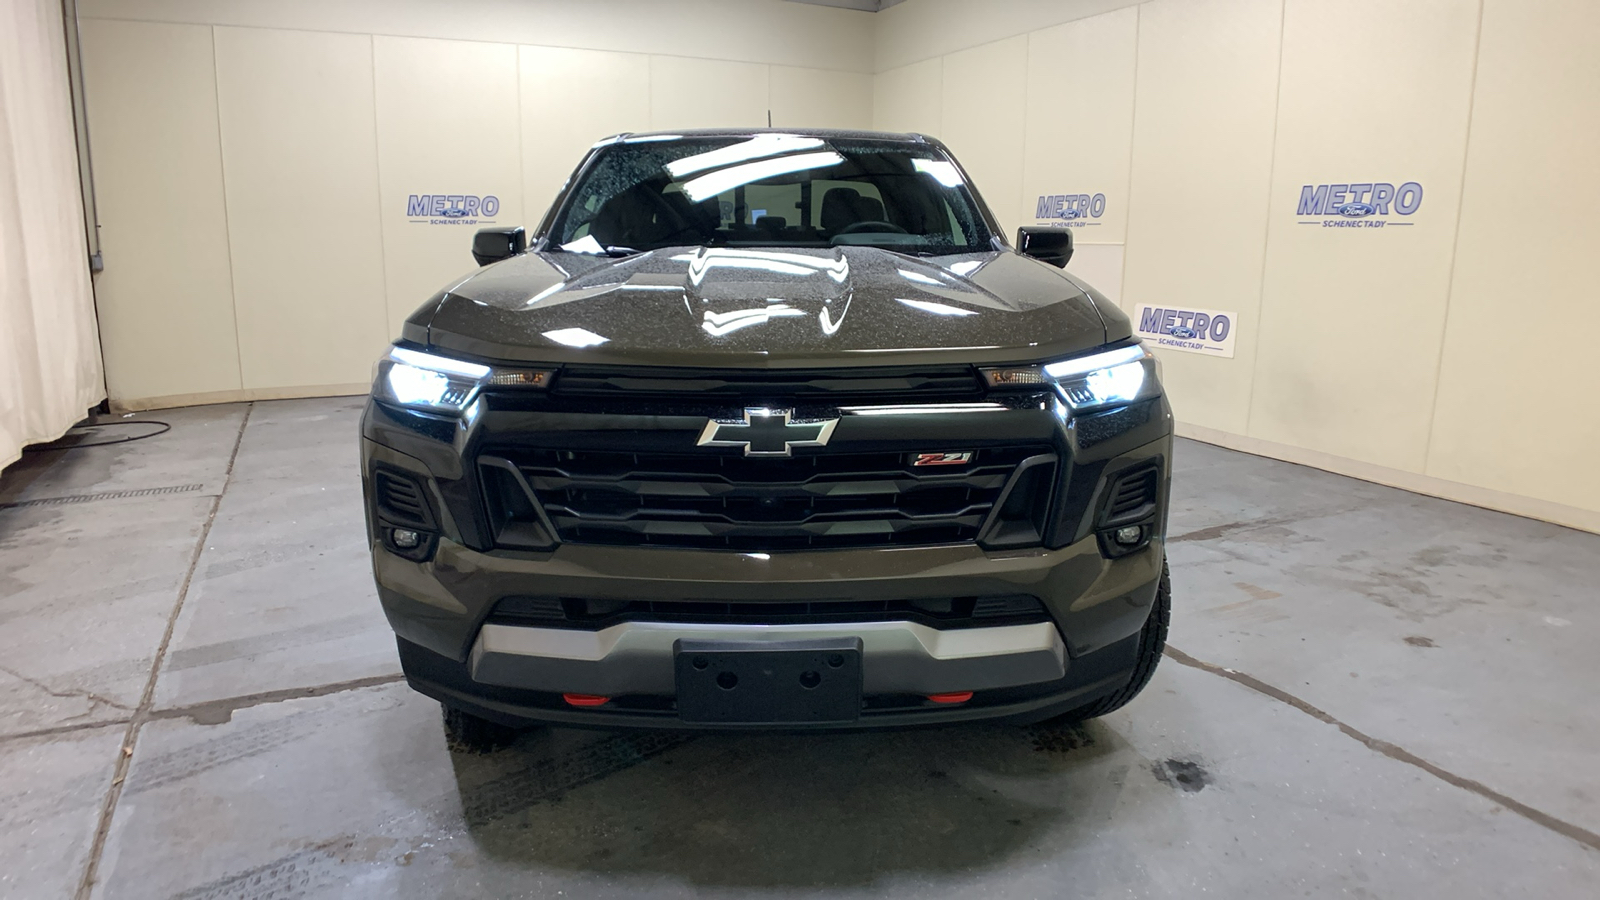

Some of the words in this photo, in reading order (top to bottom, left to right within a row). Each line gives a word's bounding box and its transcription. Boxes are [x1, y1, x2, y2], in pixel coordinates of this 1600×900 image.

[1296, 181, 1424, 216] METRO
[406, 195, 500, 217] METRO
[1035, 193, 1106, 218] METRO
[1343, 205, 1367, 216] Ford
[1322, 220, 1387, 228] SCHENECTADY
[1138, 306, 1231, 342] METRO
[1173, 328, 1191, 338] Ford
[1157, 337, 1205, 350] SCHENECTADY
[914, 453, 971, 466] Z71
